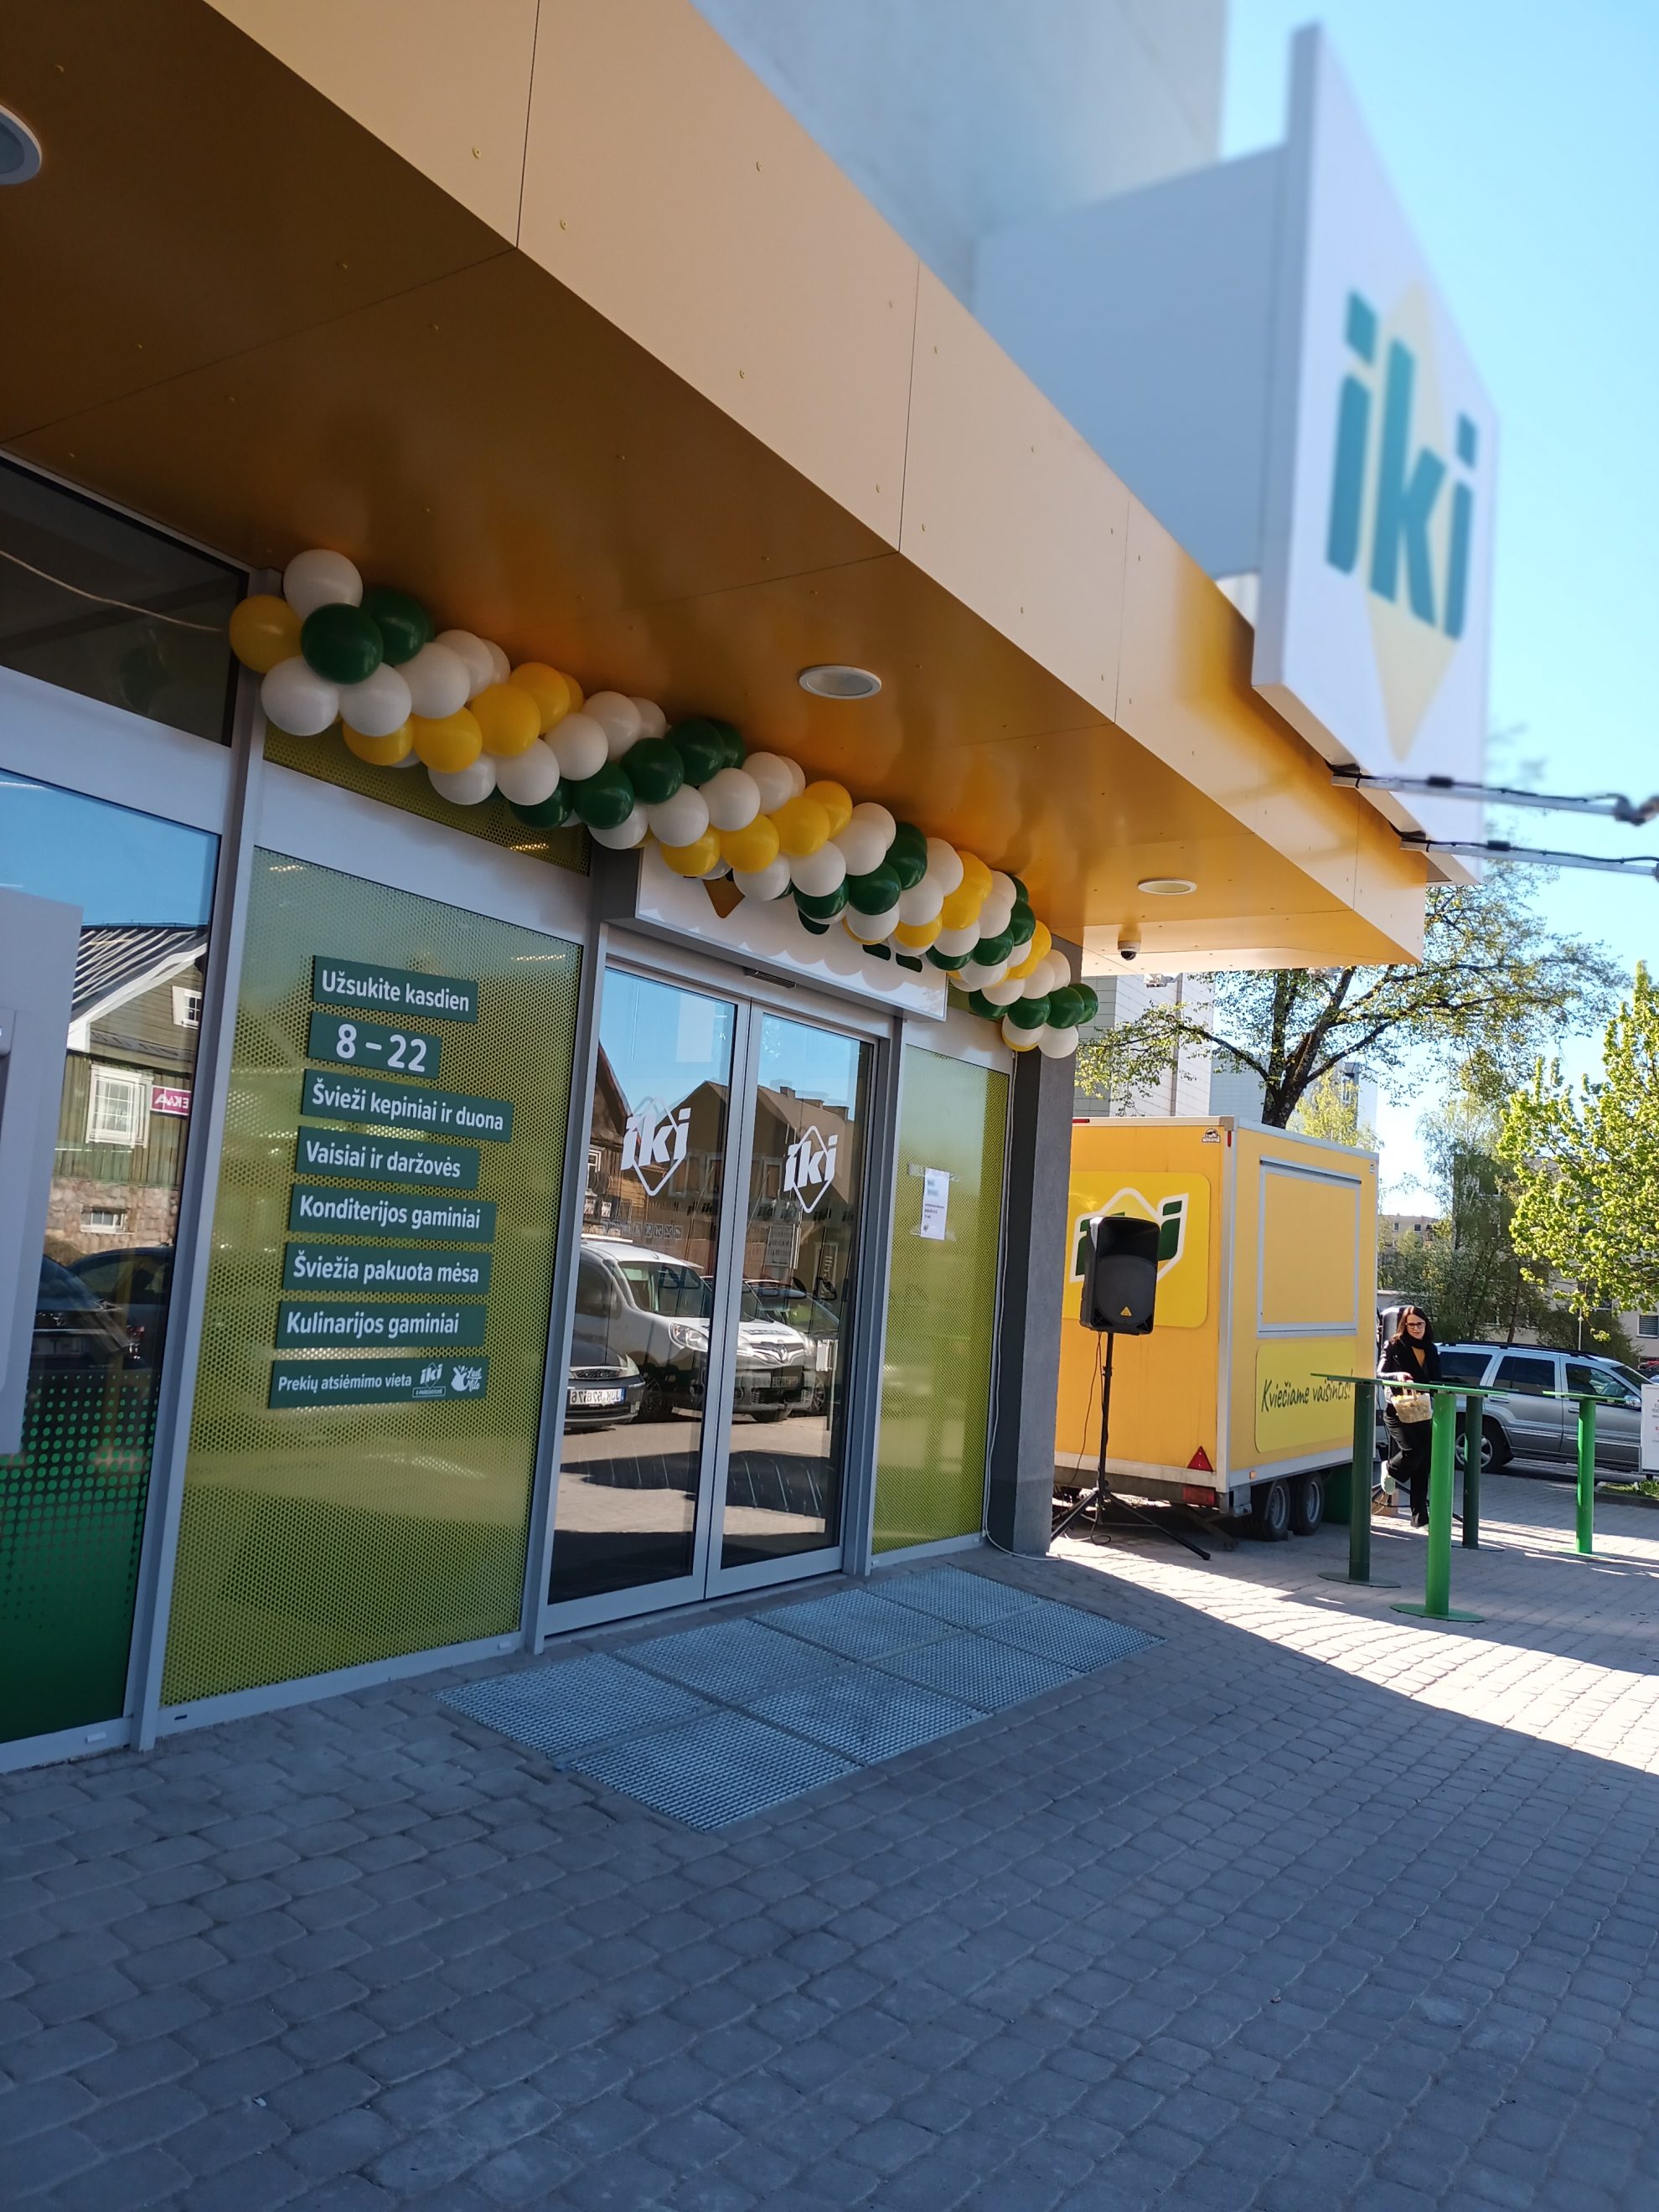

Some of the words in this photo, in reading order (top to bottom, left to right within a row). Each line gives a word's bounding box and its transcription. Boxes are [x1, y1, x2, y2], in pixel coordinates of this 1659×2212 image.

[1326, 287, 1478, 642] iki
[322, 969, 401, 1001] Užsukite
[406, 983, 469, 1011] kasdien
[336, 1024, 357, 1059] 8
[387, 1034, 427, 1072] 22
[312, 1078, 366, 1111] Švieži
[370, 1092, 437, 1120] kepiniai
[441, 1102, 452, 1122] ir
[456, 1106, 504, 1130] duona
[621, 1108, 691, 1171] iki
[306, 1140, 365, 1166] Vaisiai
[370, 1146, 384, 1169] ir
[386, 1150, 462, 1178] daržovės
[783, 1134, 838, 1192] iki
[299, 1194, 407, 1227] Konditerijos
[411, 1206, 481, 1229] gaminiai
[293, 1249, 359, 1279] Šviežia
[364, 1259, 432, 1284] pakuota
[437, 1262, 479, 1284] mėsa
[287, 1310, 385, 1339] Kulinarijos
[388, 1312, 460, 1339] gaminiai
[278, 1375, 318, 1394] Prekių
[321, 1373, 382, 1390] atsiėmimo
[385, 1372, 412, 1388] vieta
[420, 1363, 443, 1384] iki
[1261, 1379, 1310, 1413] Kviečiame
